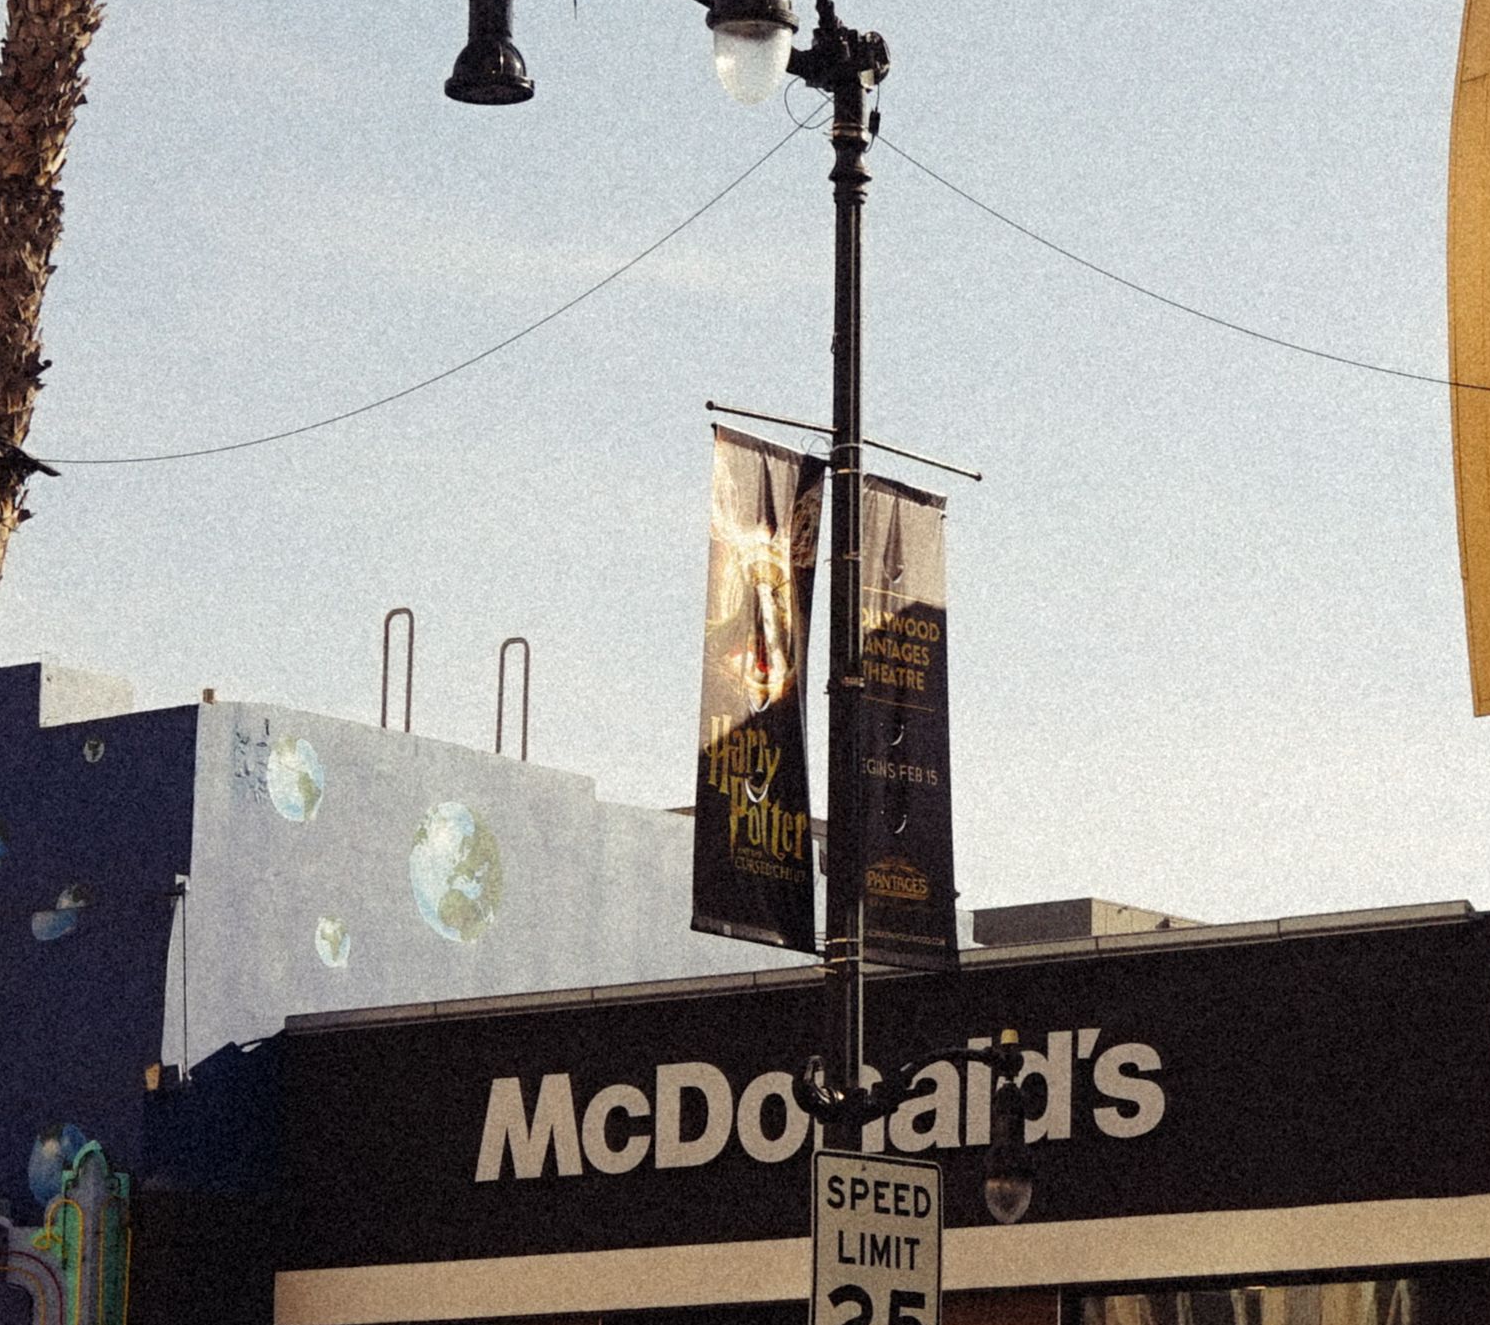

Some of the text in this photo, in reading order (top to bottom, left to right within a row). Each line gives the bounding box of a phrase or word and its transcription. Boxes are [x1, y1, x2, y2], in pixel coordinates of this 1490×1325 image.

[862, 607, 940, 642] OLLYWOOD
[863, 634, 930, 667] ANTAGES
[703, 713, 782, 795] Harry
[862, 757, 939, 786] EGINS FEB 15
[728, 775, 809, 862] Potter
[866, 869, 928, 895] PANTAGES
[826, 1174, 932, 1219] SPEED
[837, 1229, 921, 1271] LIMIT
